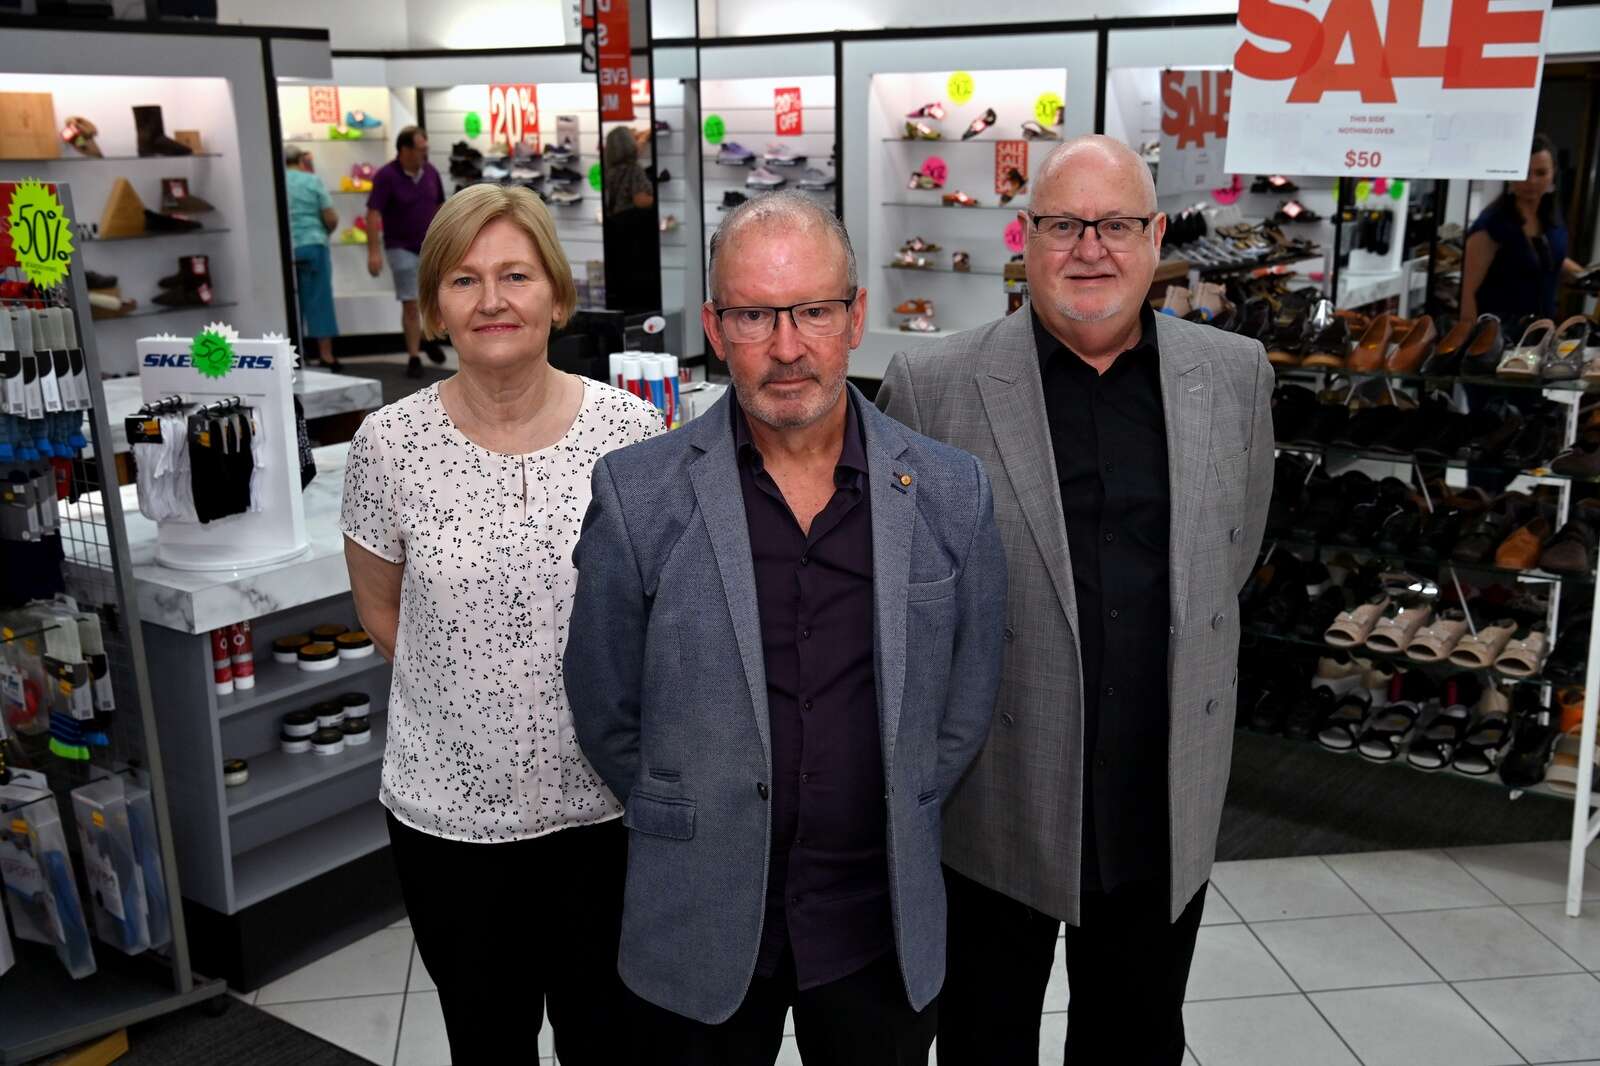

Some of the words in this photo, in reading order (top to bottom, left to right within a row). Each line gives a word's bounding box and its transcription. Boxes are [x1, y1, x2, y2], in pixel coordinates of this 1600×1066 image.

[1234, 0, 1544, 103] SALE
[776, 93, 801, 113] 20%
[1161, 70, 1232, 150] SALE
[490, 87, 537, 150] 20%
[780, 112, 799, 131] OFF
[1338, 127, 1373, 135] NOTHING
[1374, 127, 1395, 135] OVER
[1344, 150, 1382, 168] $50
[143, 353, 274, 370] SKEERS
